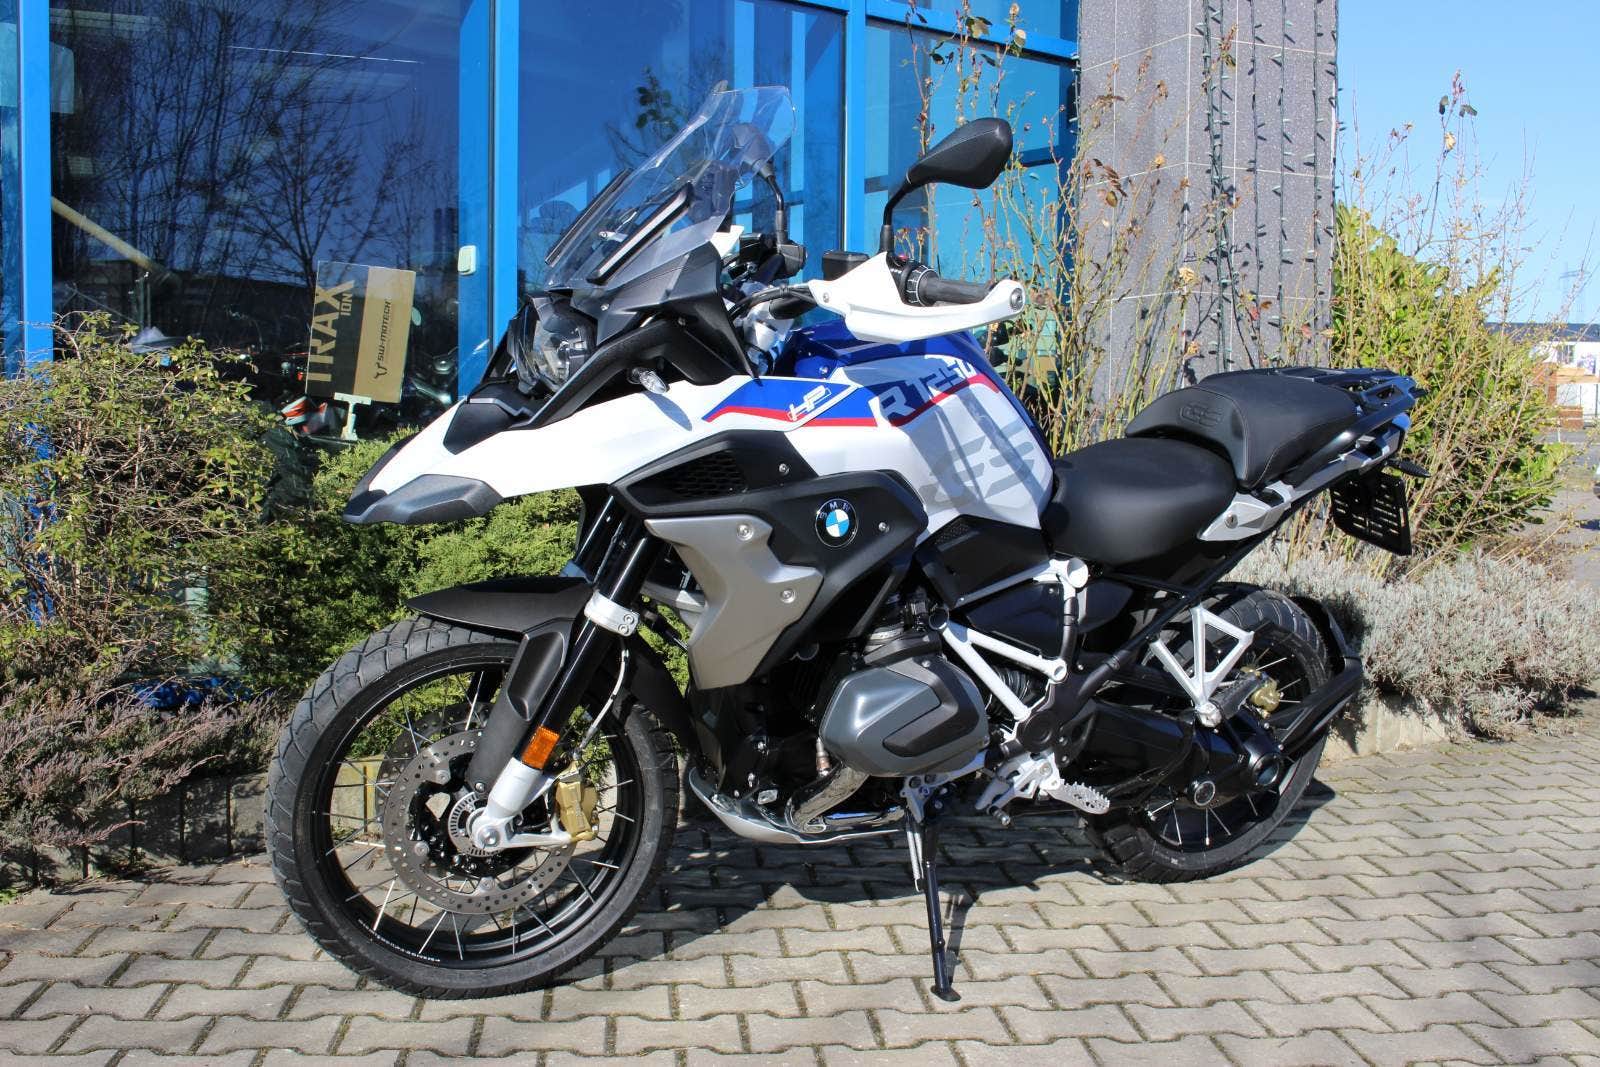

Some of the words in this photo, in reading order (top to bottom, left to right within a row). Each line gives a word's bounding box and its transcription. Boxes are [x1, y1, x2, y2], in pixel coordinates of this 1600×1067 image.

[788, 384, 829, 421] HP
[879, 386, 916, 419] R
[819, 501, 851, 519] BMW
